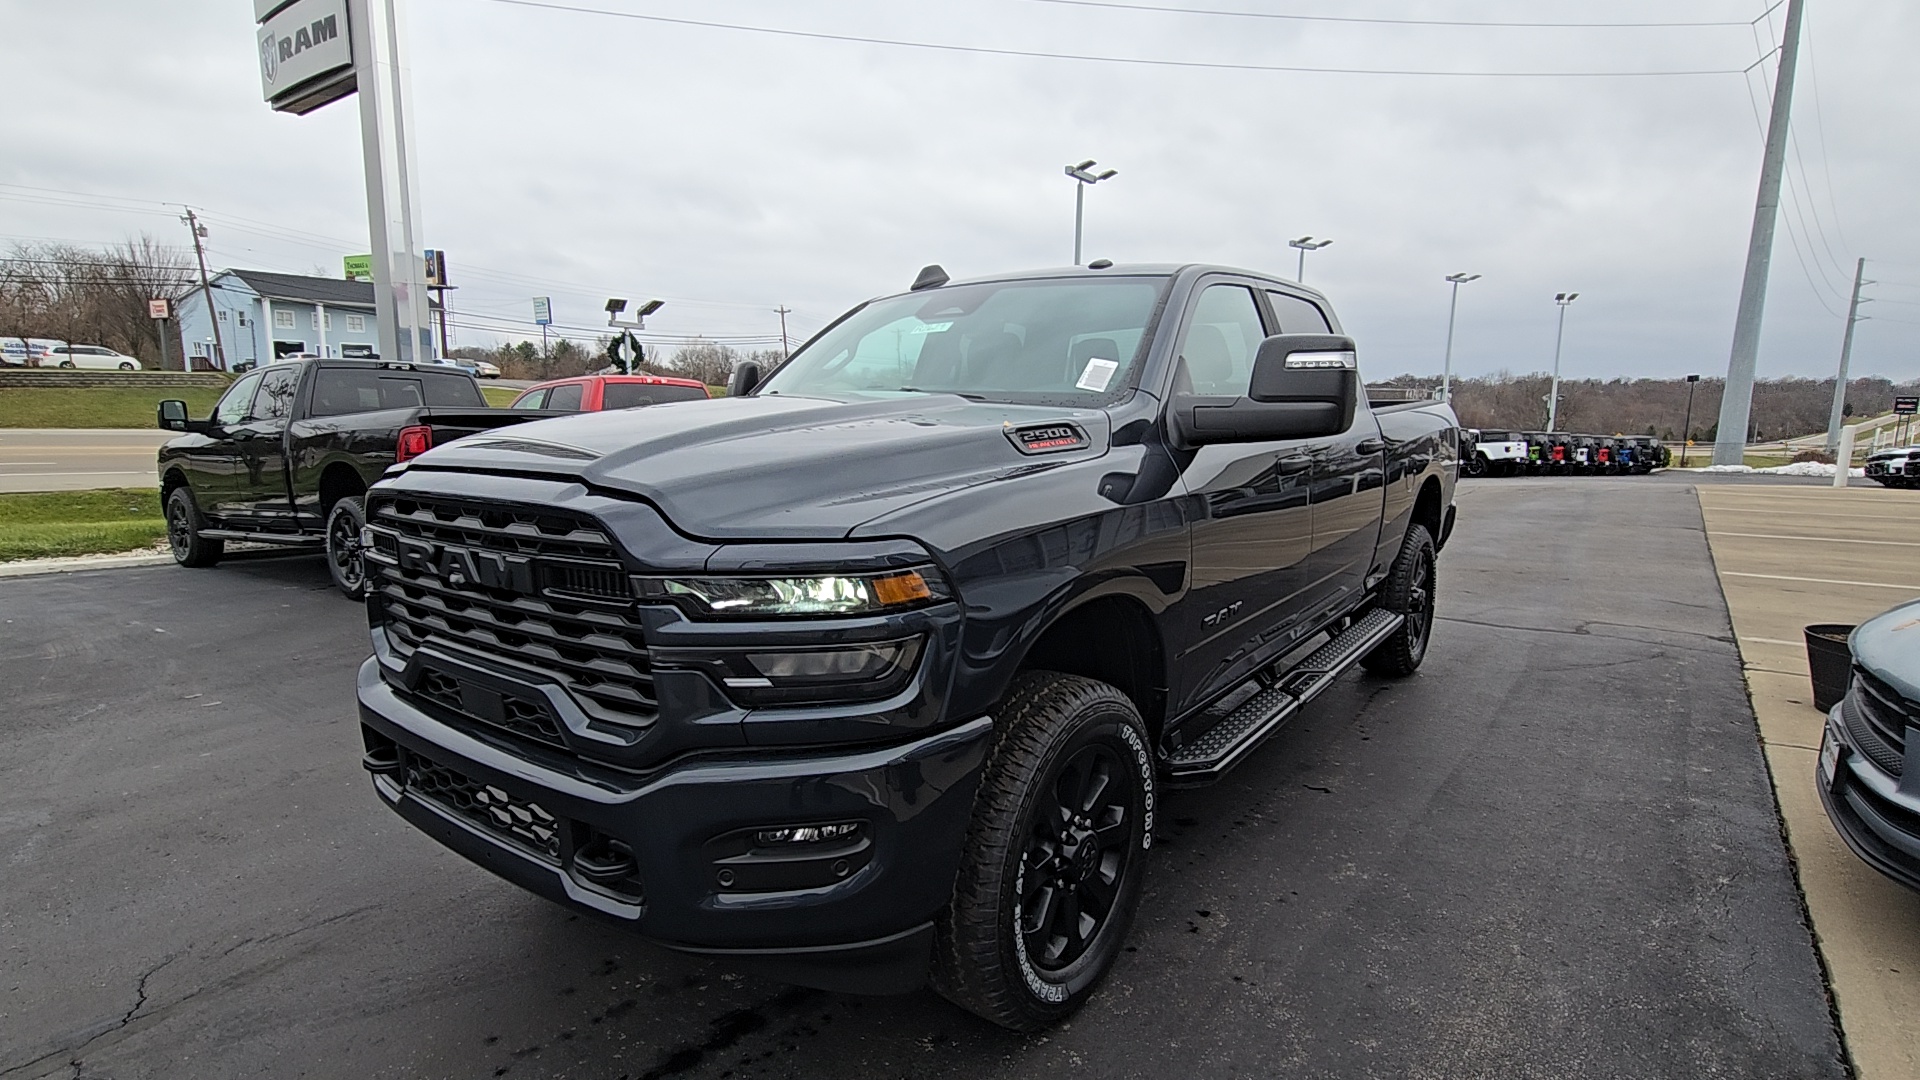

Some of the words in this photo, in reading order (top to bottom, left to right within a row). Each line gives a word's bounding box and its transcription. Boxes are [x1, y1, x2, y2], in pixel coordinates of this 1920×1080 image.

[278, 14, 337, 63] RAM
[1023, 427, 1072, 441] 2500
[398, 537, 533, 593] RAM
